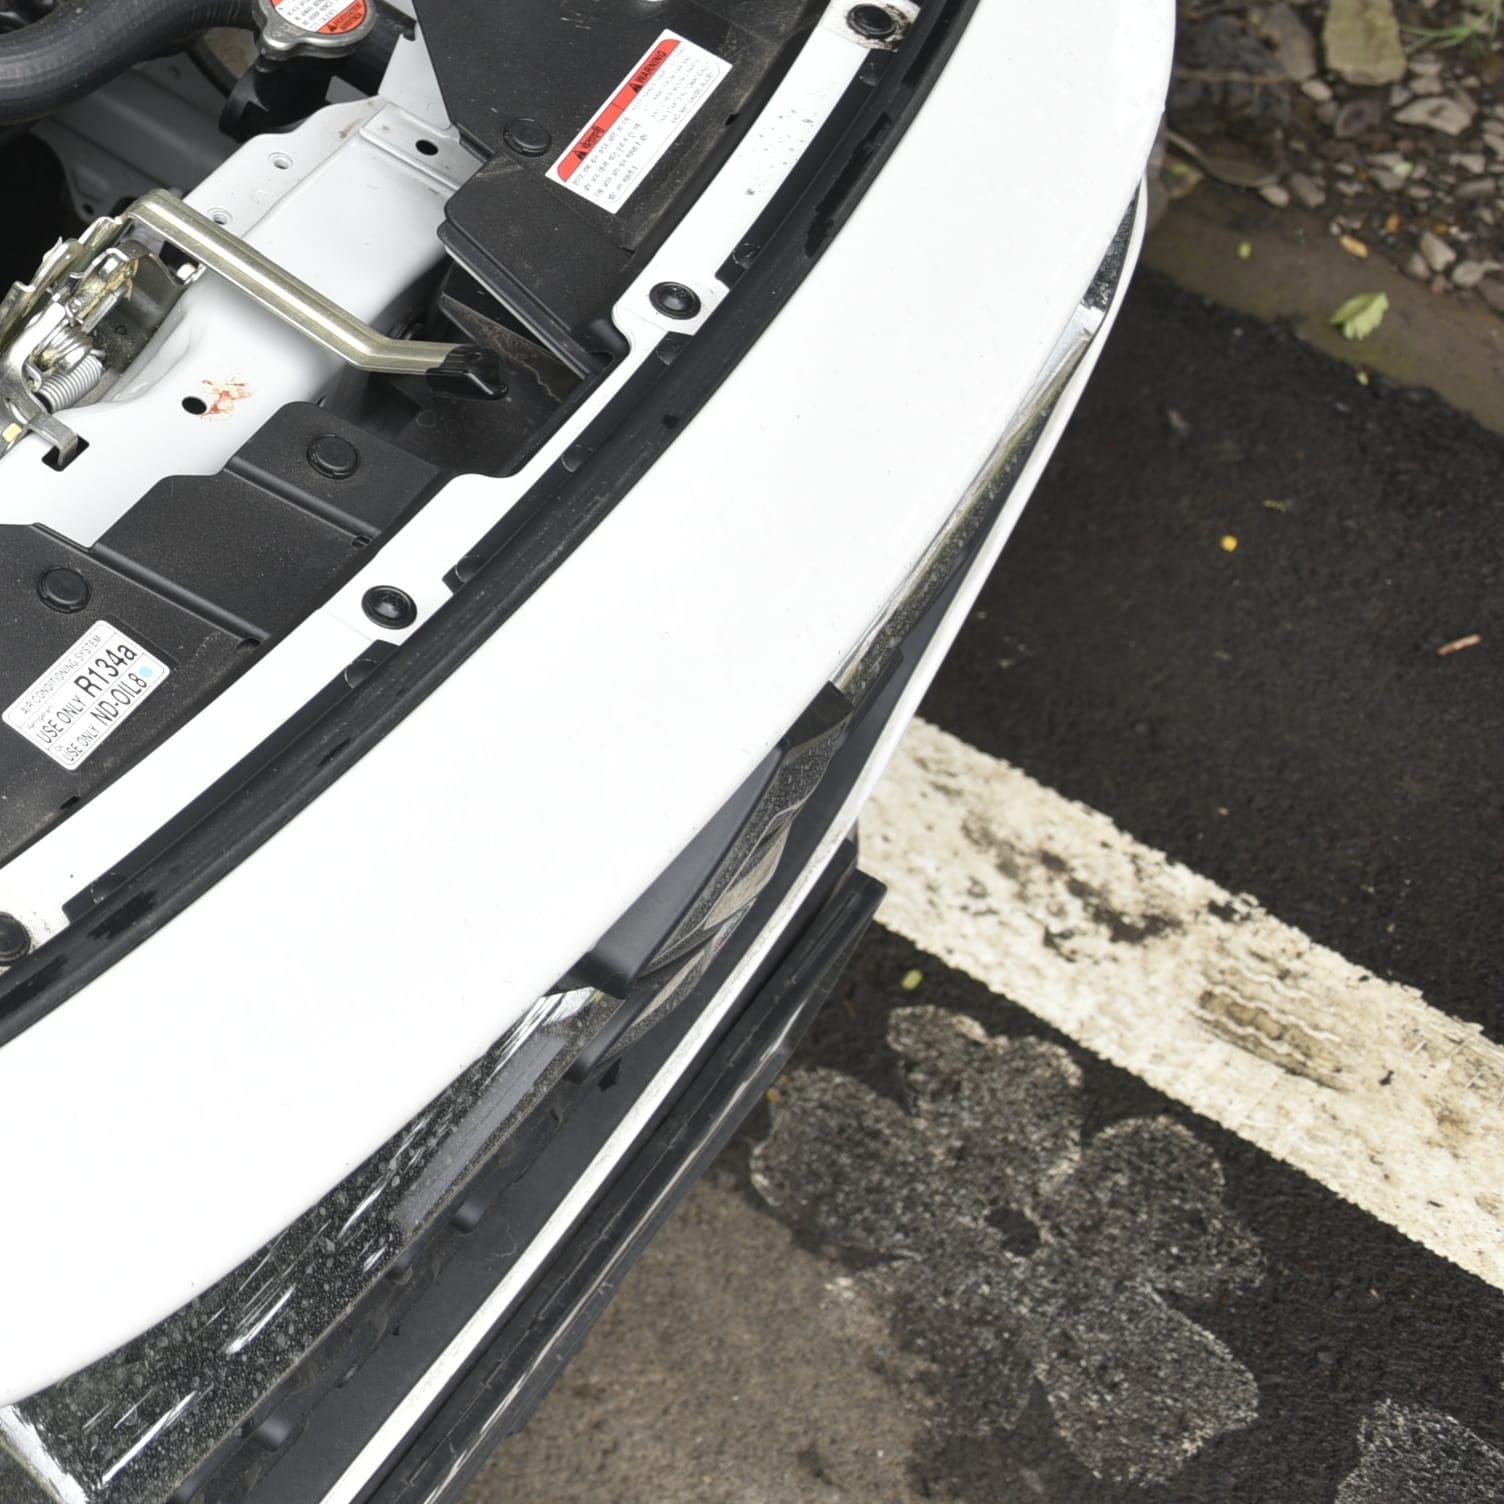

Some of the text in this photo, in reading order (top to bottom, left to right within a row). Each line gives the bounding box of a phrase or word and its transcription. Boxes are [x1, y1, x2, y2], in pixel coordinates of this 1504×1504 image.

[635, 50, 667, 84] WARNING
[21, 634, 103, 715] AIR CONDITIONING SYSTEM
[37, 644, 138, 744] USE ONLY R134a
[62, 672, 148, 762] USE ONLY ND-OIL8
